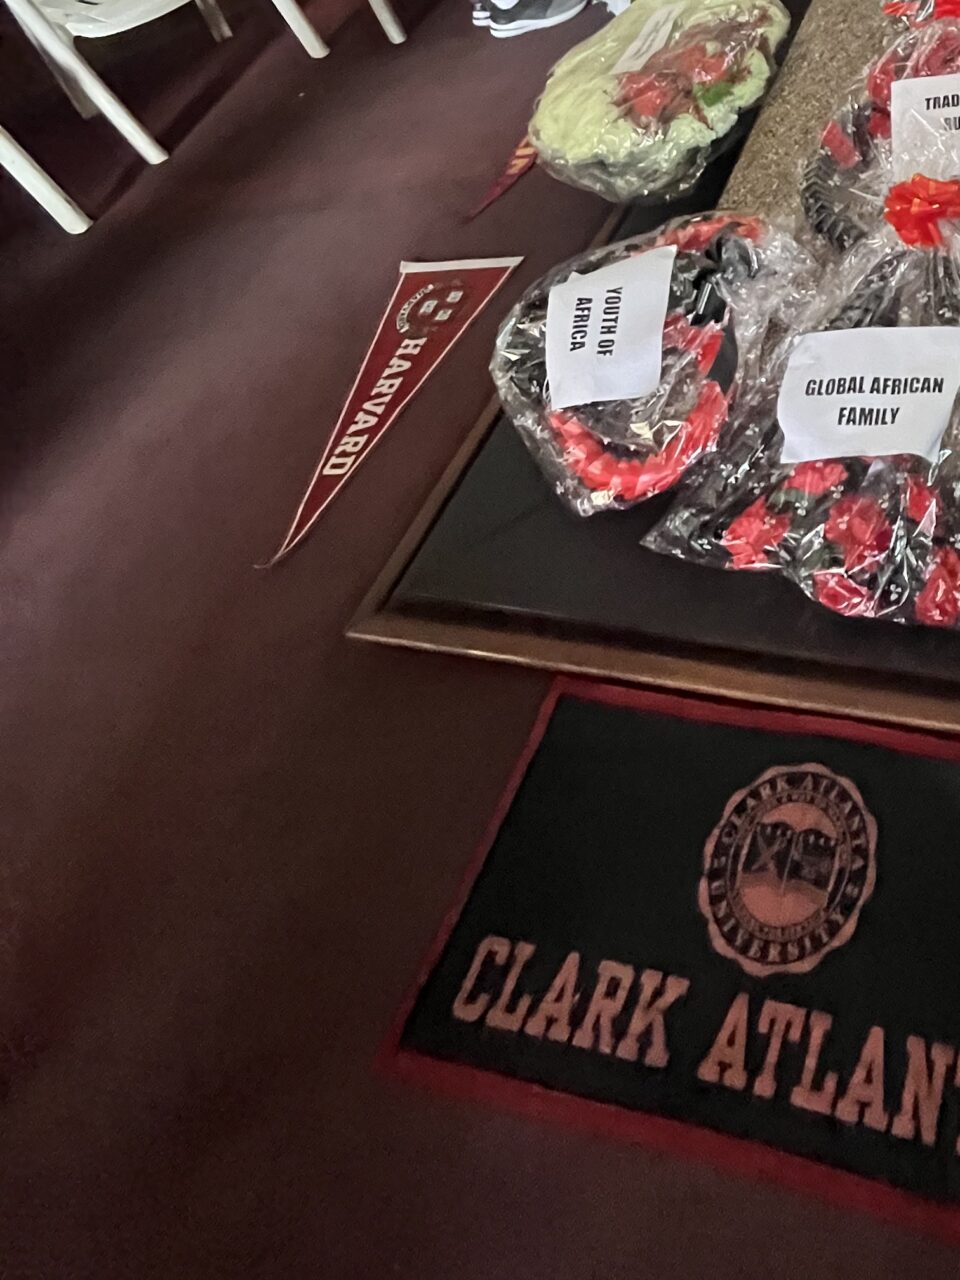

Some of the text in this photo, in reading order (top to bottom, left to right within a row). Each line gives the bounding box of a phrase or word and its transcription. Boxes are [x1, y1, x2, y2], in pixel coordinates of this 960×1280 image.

[569, 297, 593, 352] AFRICA
[596, 286, 623, 356] YOUTH OF
[322, 337, 428, 476] HARVARD
[805, 376, 945, 396] GLOBAL AFRICAN
[837, 406, 900, 426] FAMILY
[451, 933, 691, 1068] CLARK
